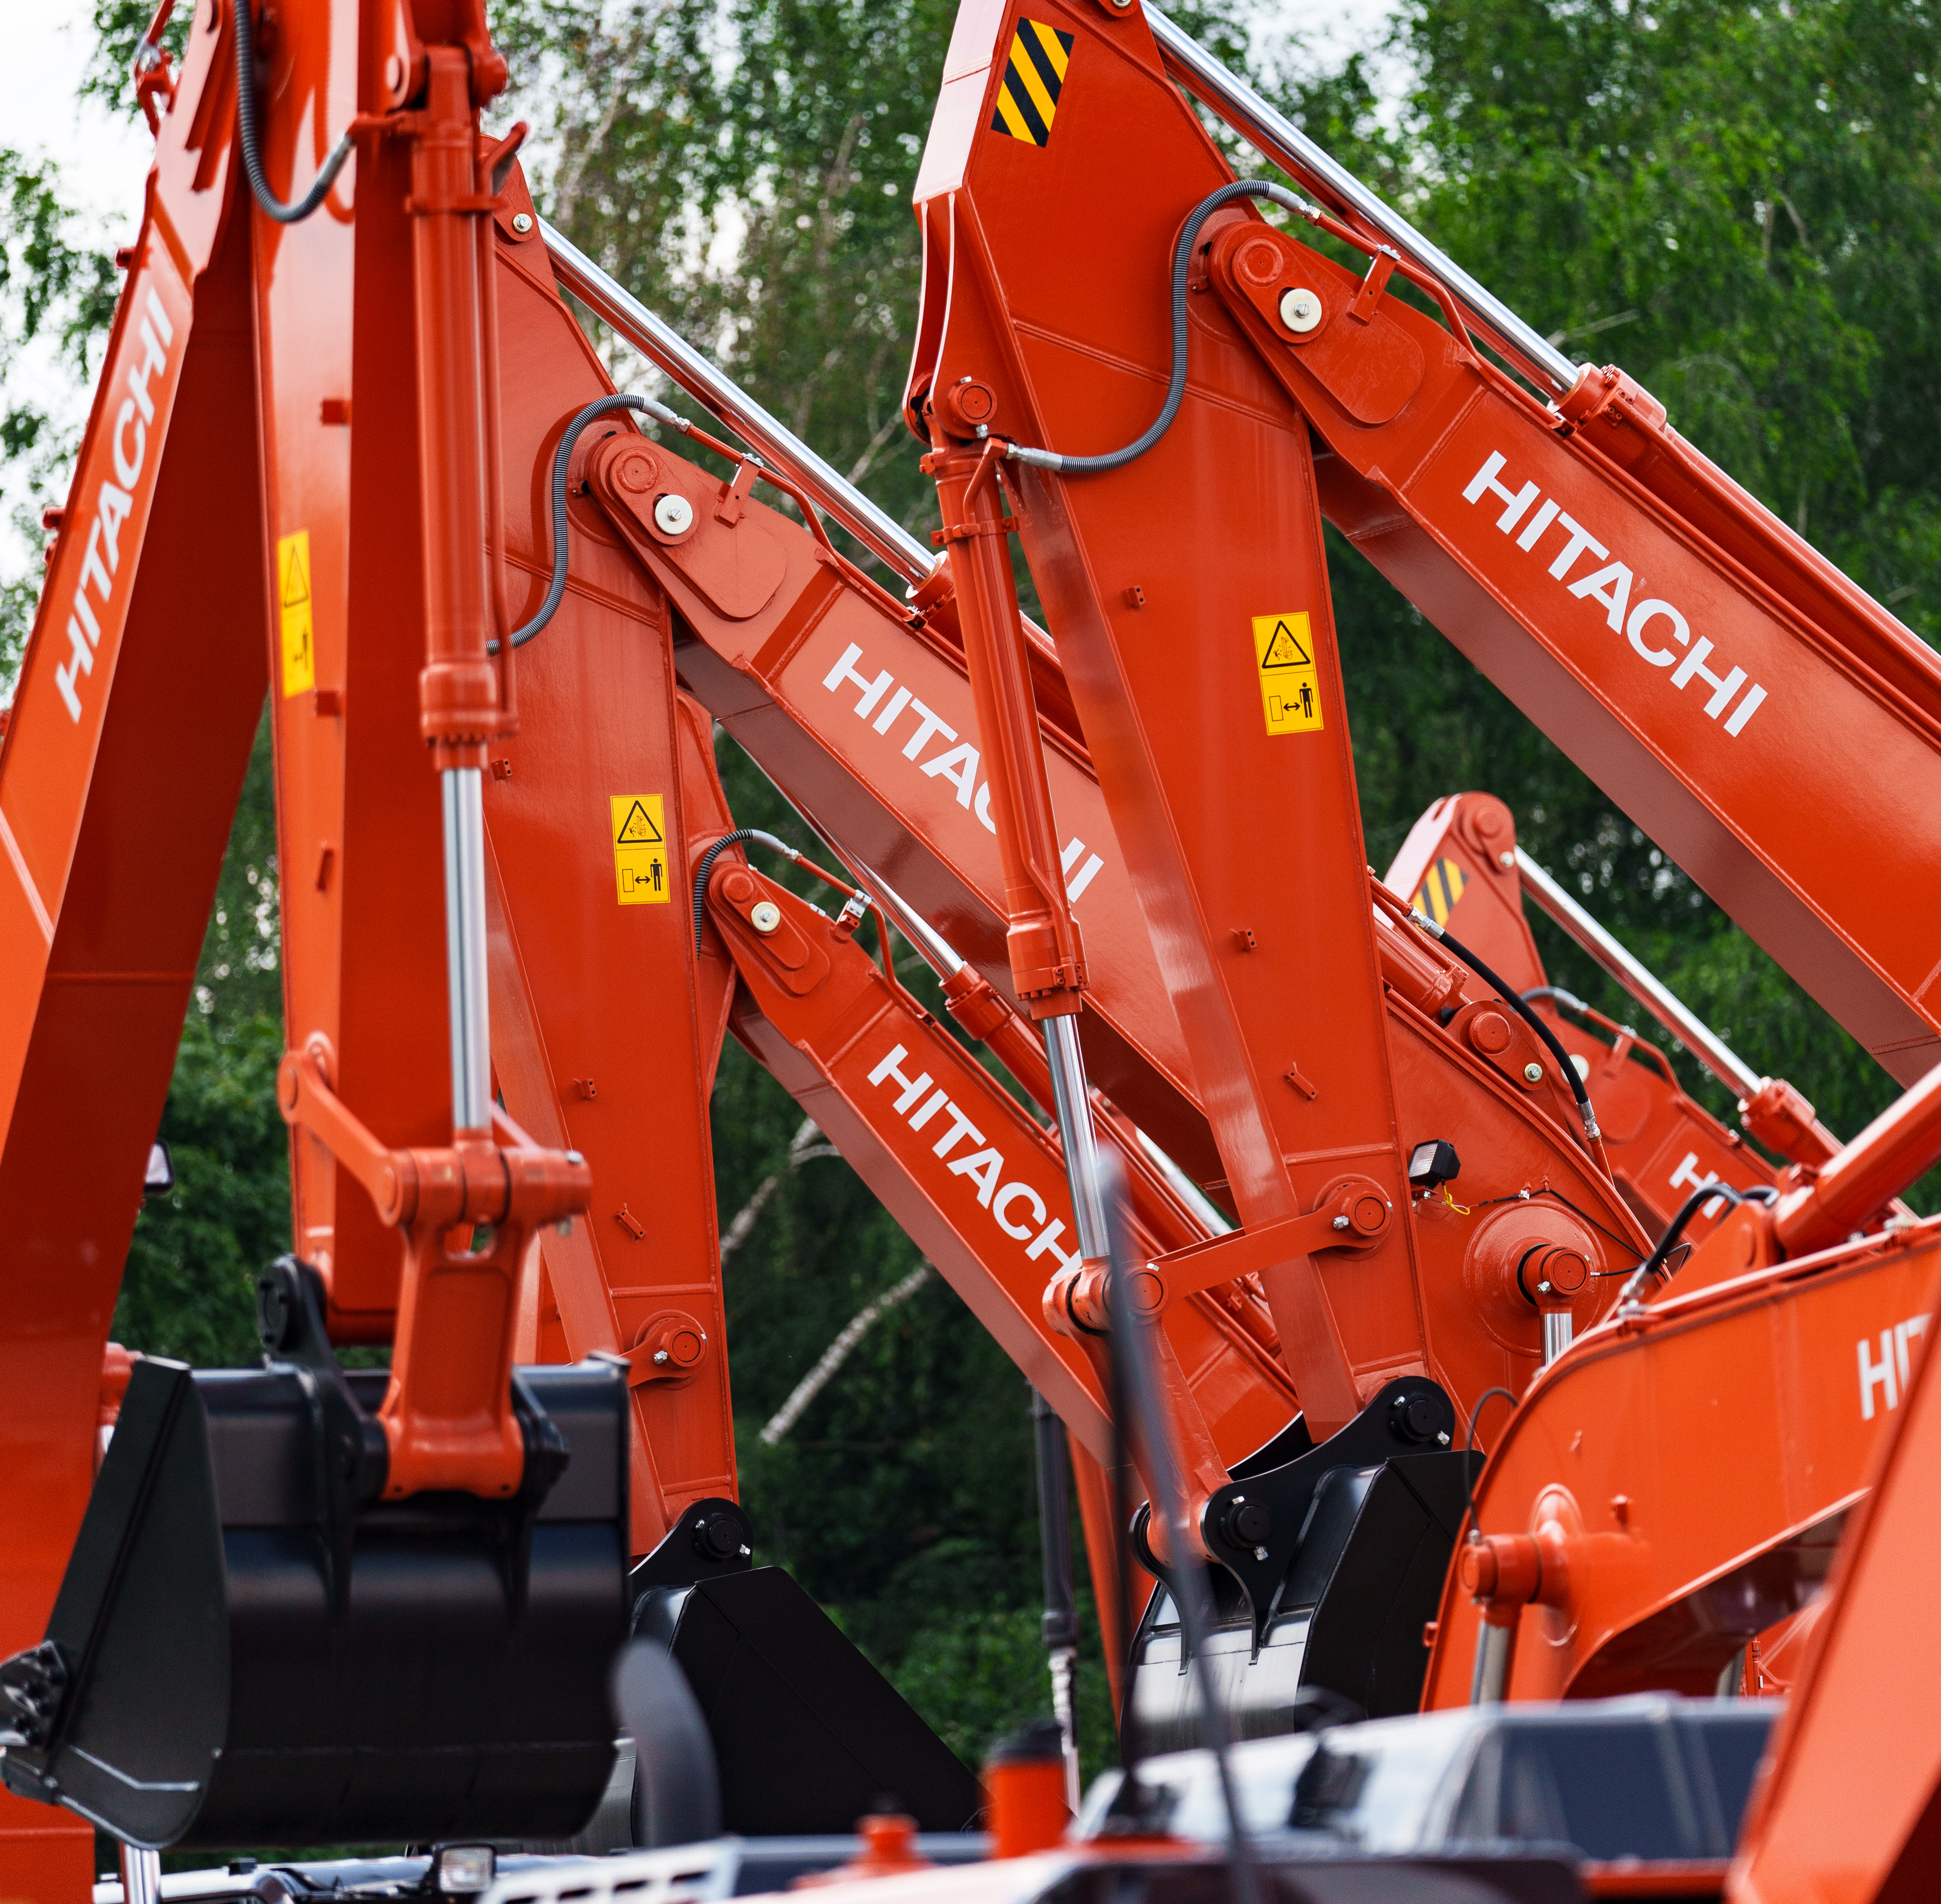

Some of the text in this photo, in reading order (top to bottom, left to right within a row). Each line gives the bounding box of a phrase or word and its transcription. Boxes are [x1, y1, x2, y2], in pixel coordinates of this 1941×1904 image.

[55, 286, 173, 725] HITACHI
[1462, 449, 1768, 738] HITACHI
[867, 1043, 1083, 1281] HITACH
